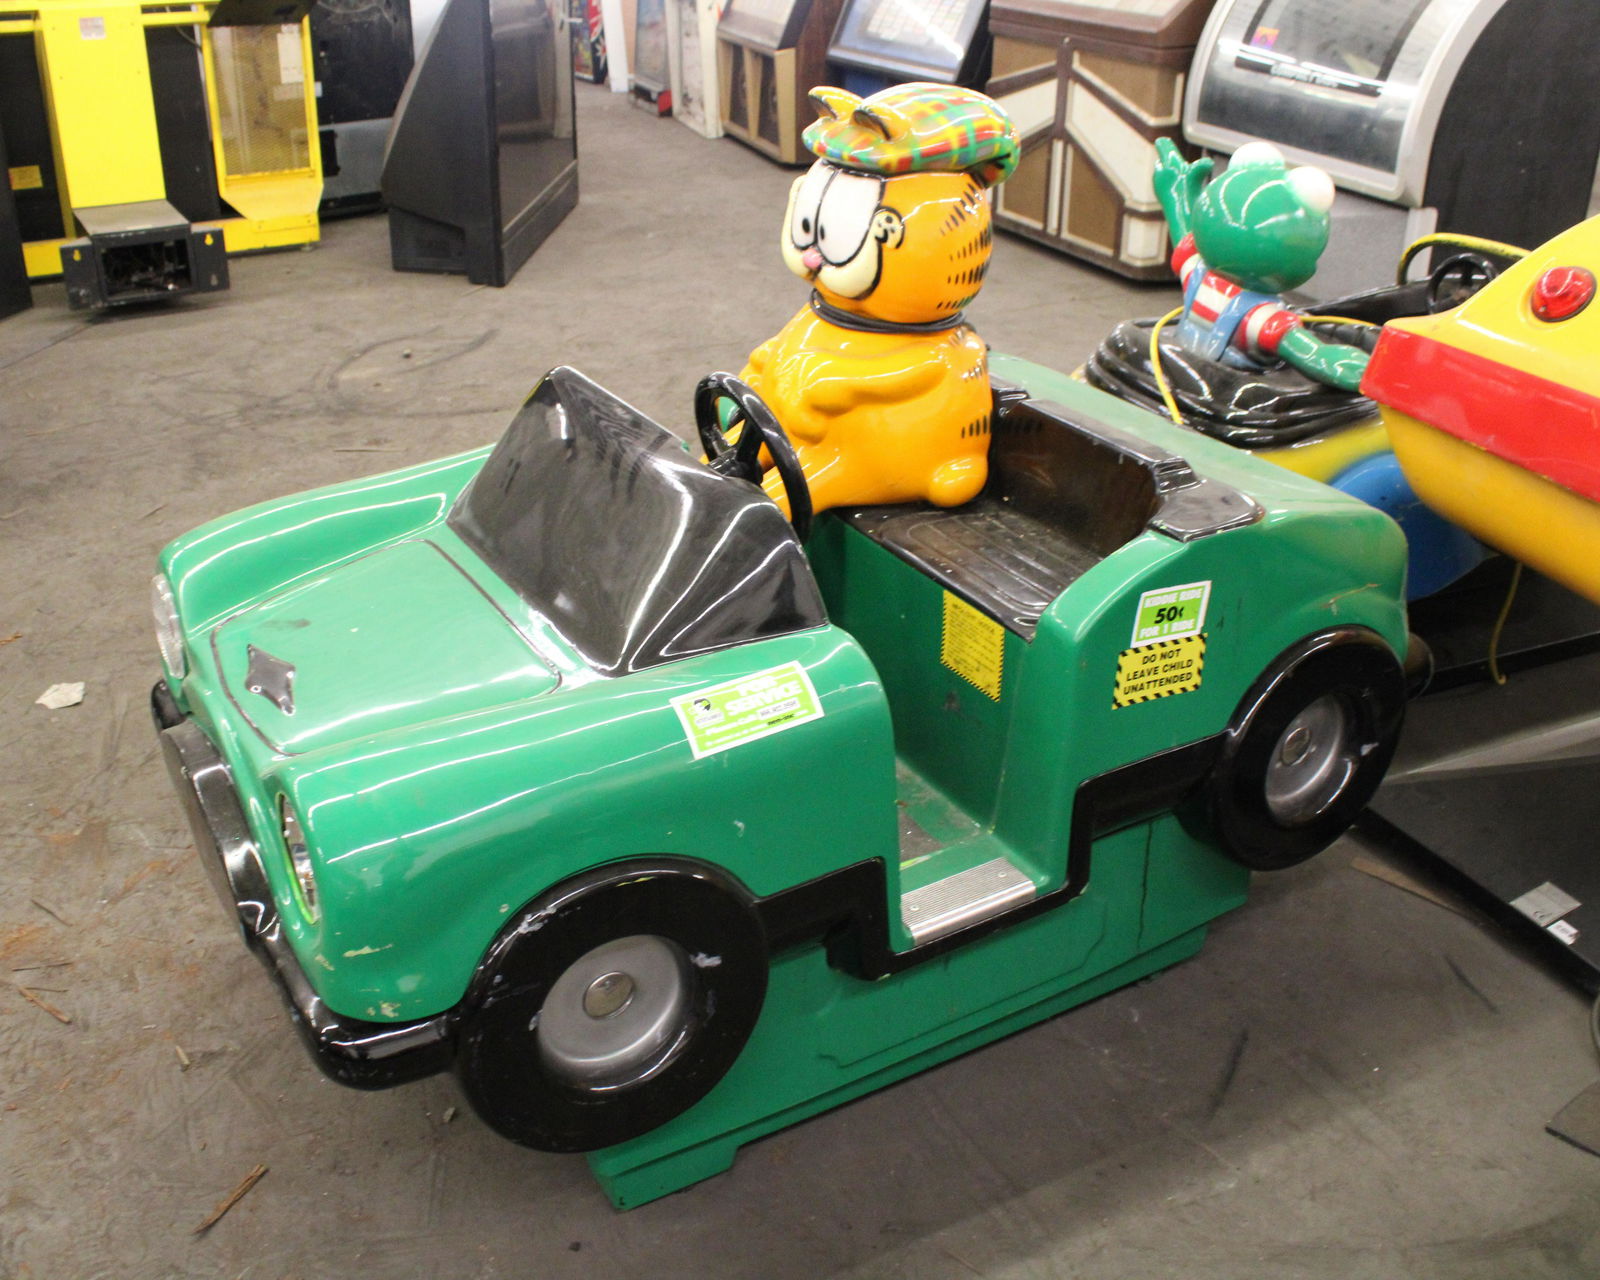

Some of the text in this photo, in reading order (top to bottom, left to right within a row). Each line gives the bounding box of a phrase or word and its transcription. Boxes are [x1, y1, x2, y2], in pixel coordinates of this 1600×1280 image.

[1140, 626, 1159, 638] FOR
[1171, 620, 1194, 631] RIDE
[1142, 649, 1181, 665] DO NOT
[1126, 659, 1193, 681] LEAVE CHILD
[1123, 672, 1193, 695] UNATTENDED
[724, 680, 803, 717] SERVICE
